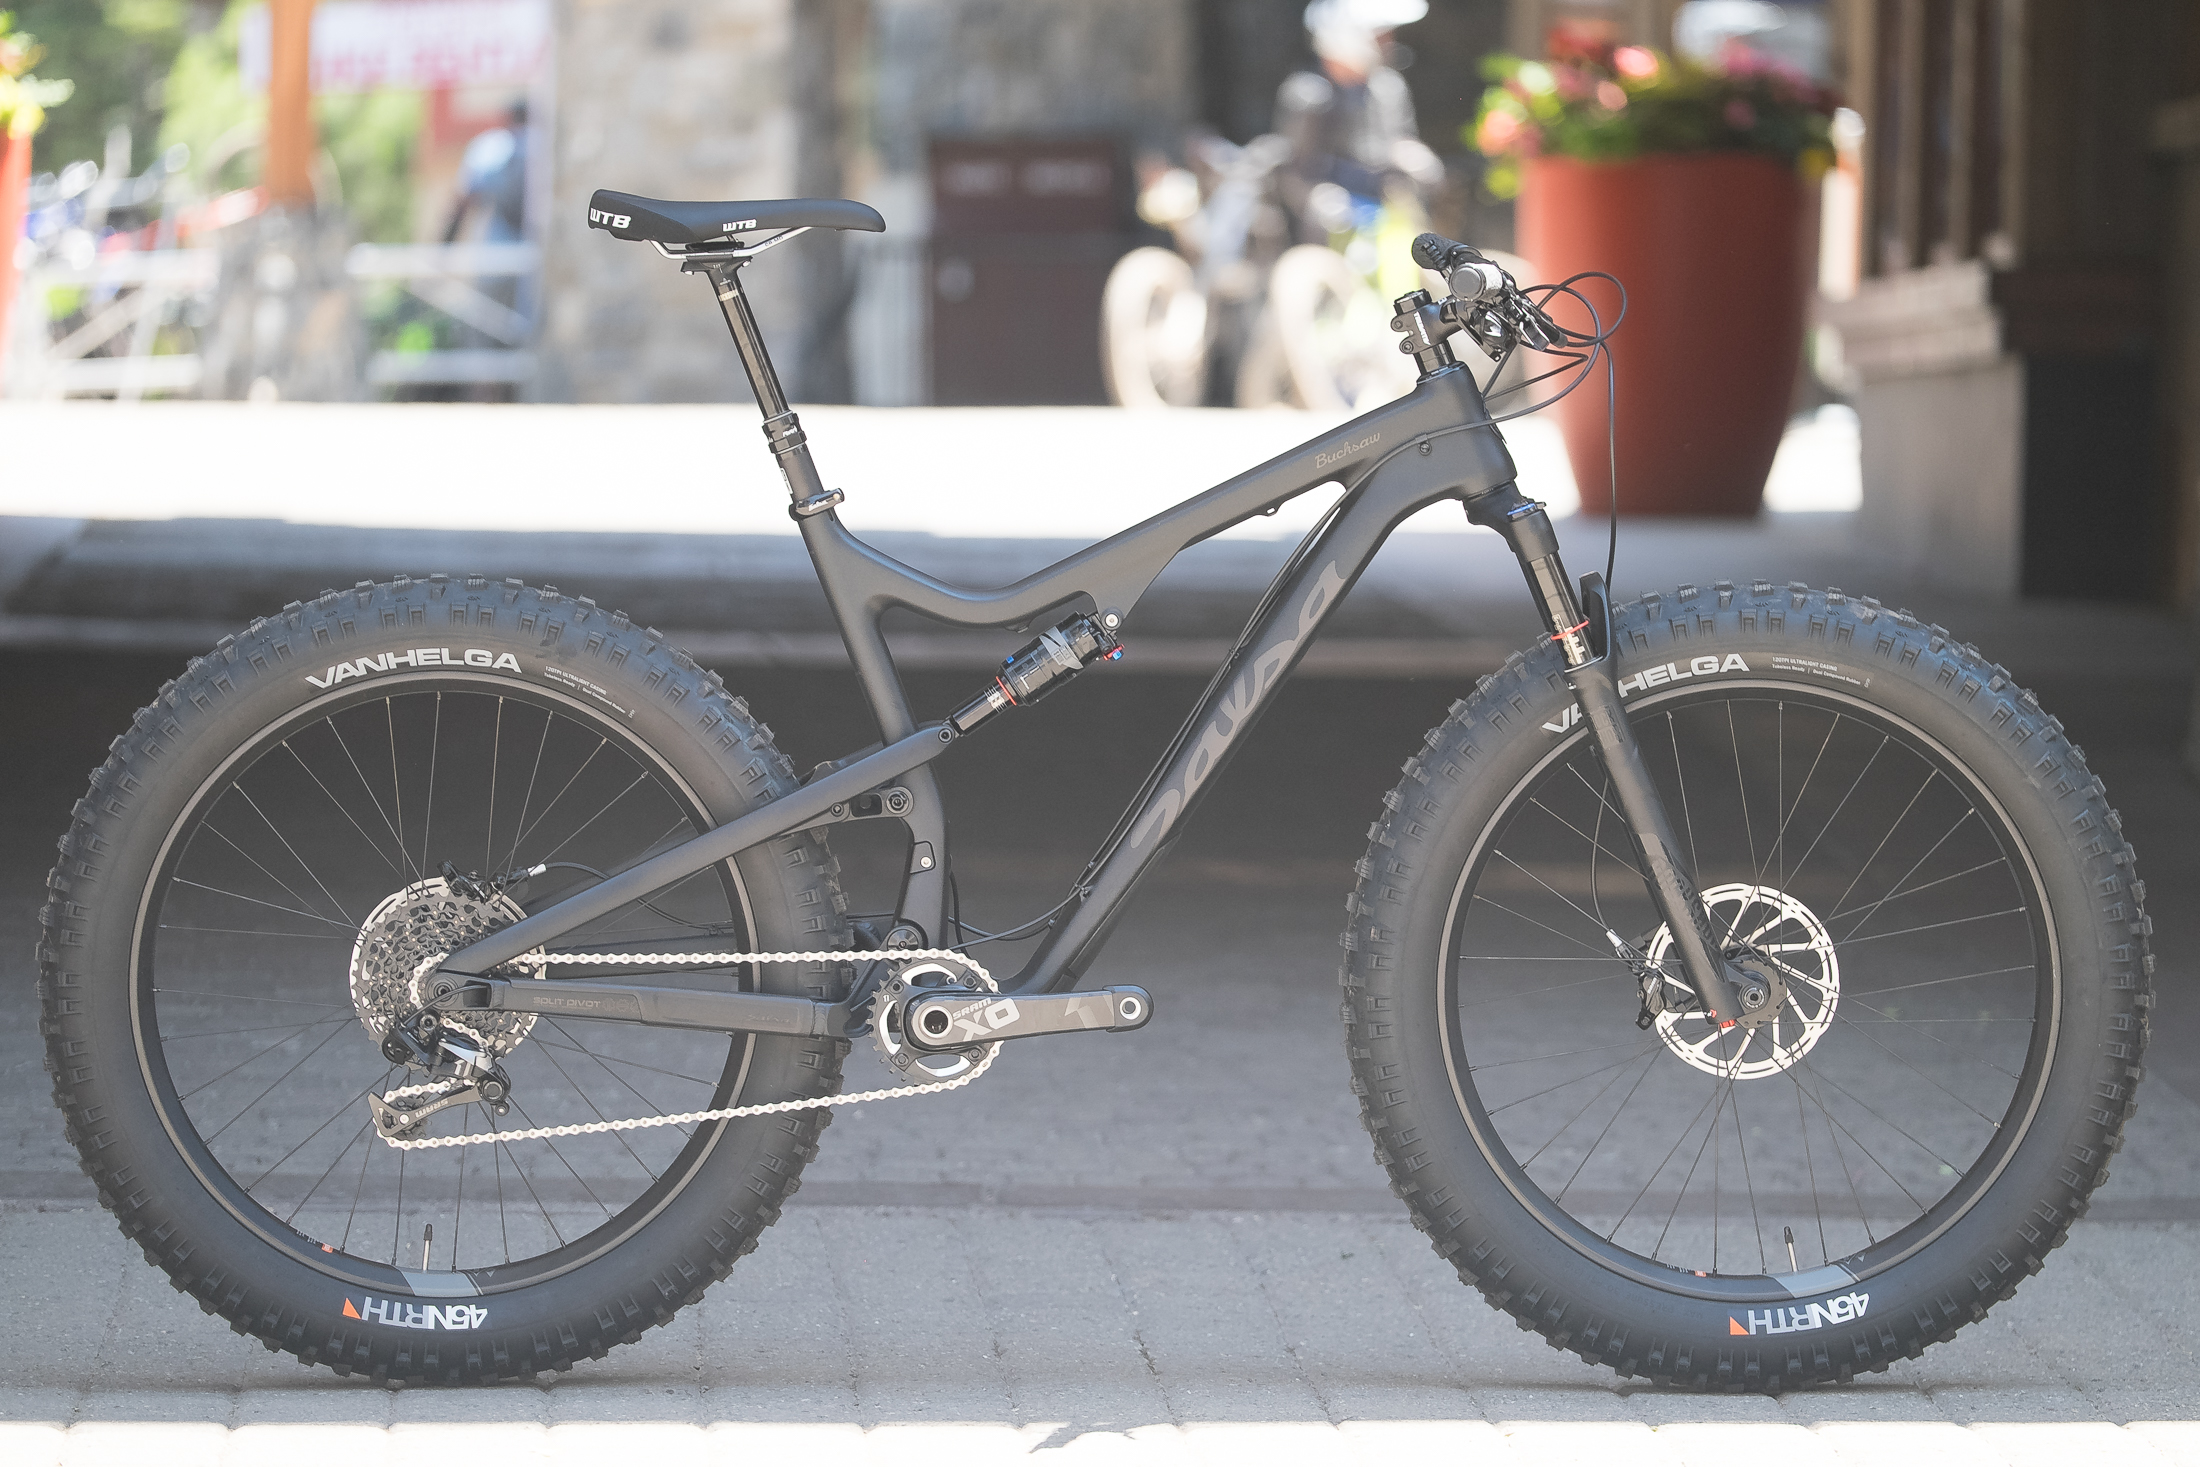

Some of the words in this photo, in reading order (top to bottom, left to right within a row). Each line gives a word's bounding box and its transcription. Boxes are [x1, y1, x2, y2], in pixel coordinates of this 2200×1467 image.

[590, 207, 632, 229] WTB
[722, 218, 757, 232] WTB
[305, 648, 523, 689] VANHELGA
[1819, 662, 1838, 672] CASING
[952, 997, 992, 1019] SRAM
[415, 1098, 449, 1118] SRAM
[361, 1296, 488, 1329] 45NRTH
[1747, 1292, 1870, 1335] 45NRTH
